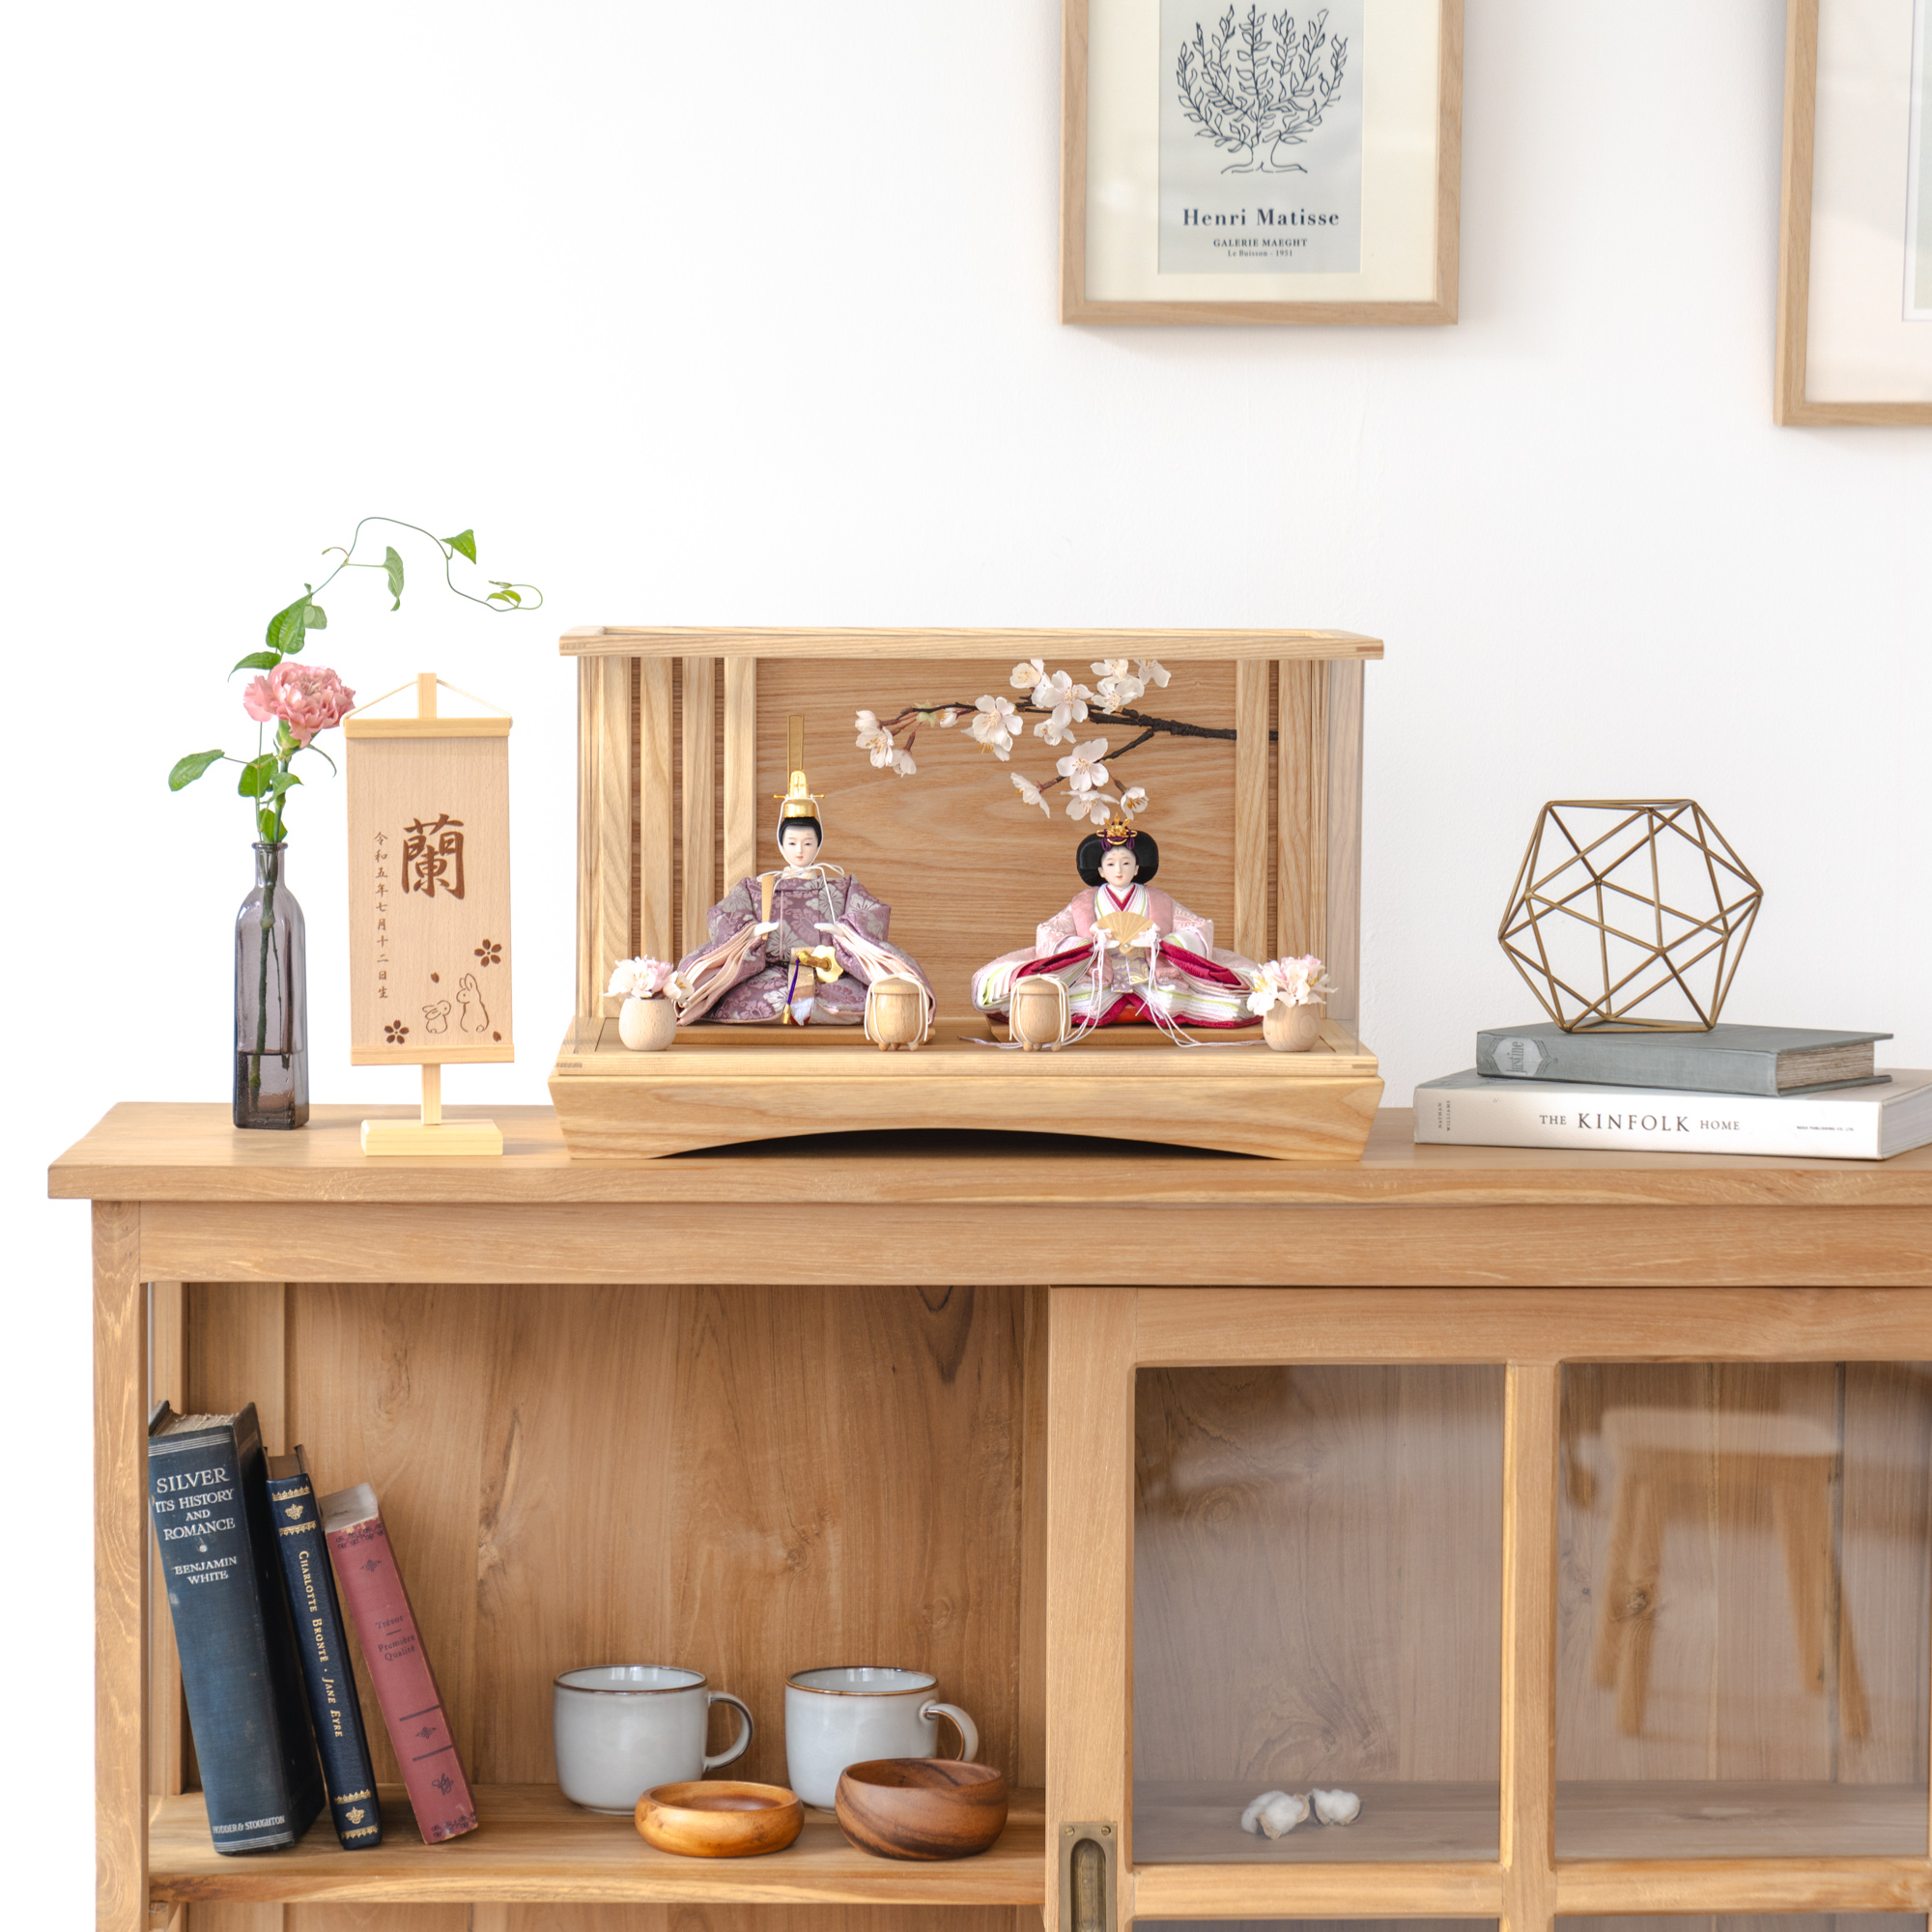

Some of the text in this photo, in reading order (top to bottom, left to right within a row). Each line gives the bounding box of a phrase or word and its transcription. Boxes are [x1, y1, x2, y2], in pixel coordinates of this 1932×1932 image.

[1182, 209, 1340, 226] Henri Matisse
[1213, 239, 1308, 247] GALERIE MAEGHT
[401, 812, 466, 900] 蘭
[373, 831, 389, 1000] 令和五年七月十二日生
[1506, 1041, 1527, 1075] Justine
[1539, 1113, 1741, 1132] THE KINFOLK HOME
[156, 1467, 230, 1493] SILVER
[156, 1489, 235, 1514] ITS HISTORY
[185, 1509, 211, 1521] AND
[163, 1518, 236, 1541] ROMANCE
[174, 1556, 238, 1576] BENJAMIN
[186, 1570, 229, 1585] WHITE
[298, 1550, 318, 1612] CHARLOTTE
[322, 1677, 336, 1704] JANE
[330, 1709, 343, 1738] EYRE
[244, 1815, 285, 1831] STOUGHTON
